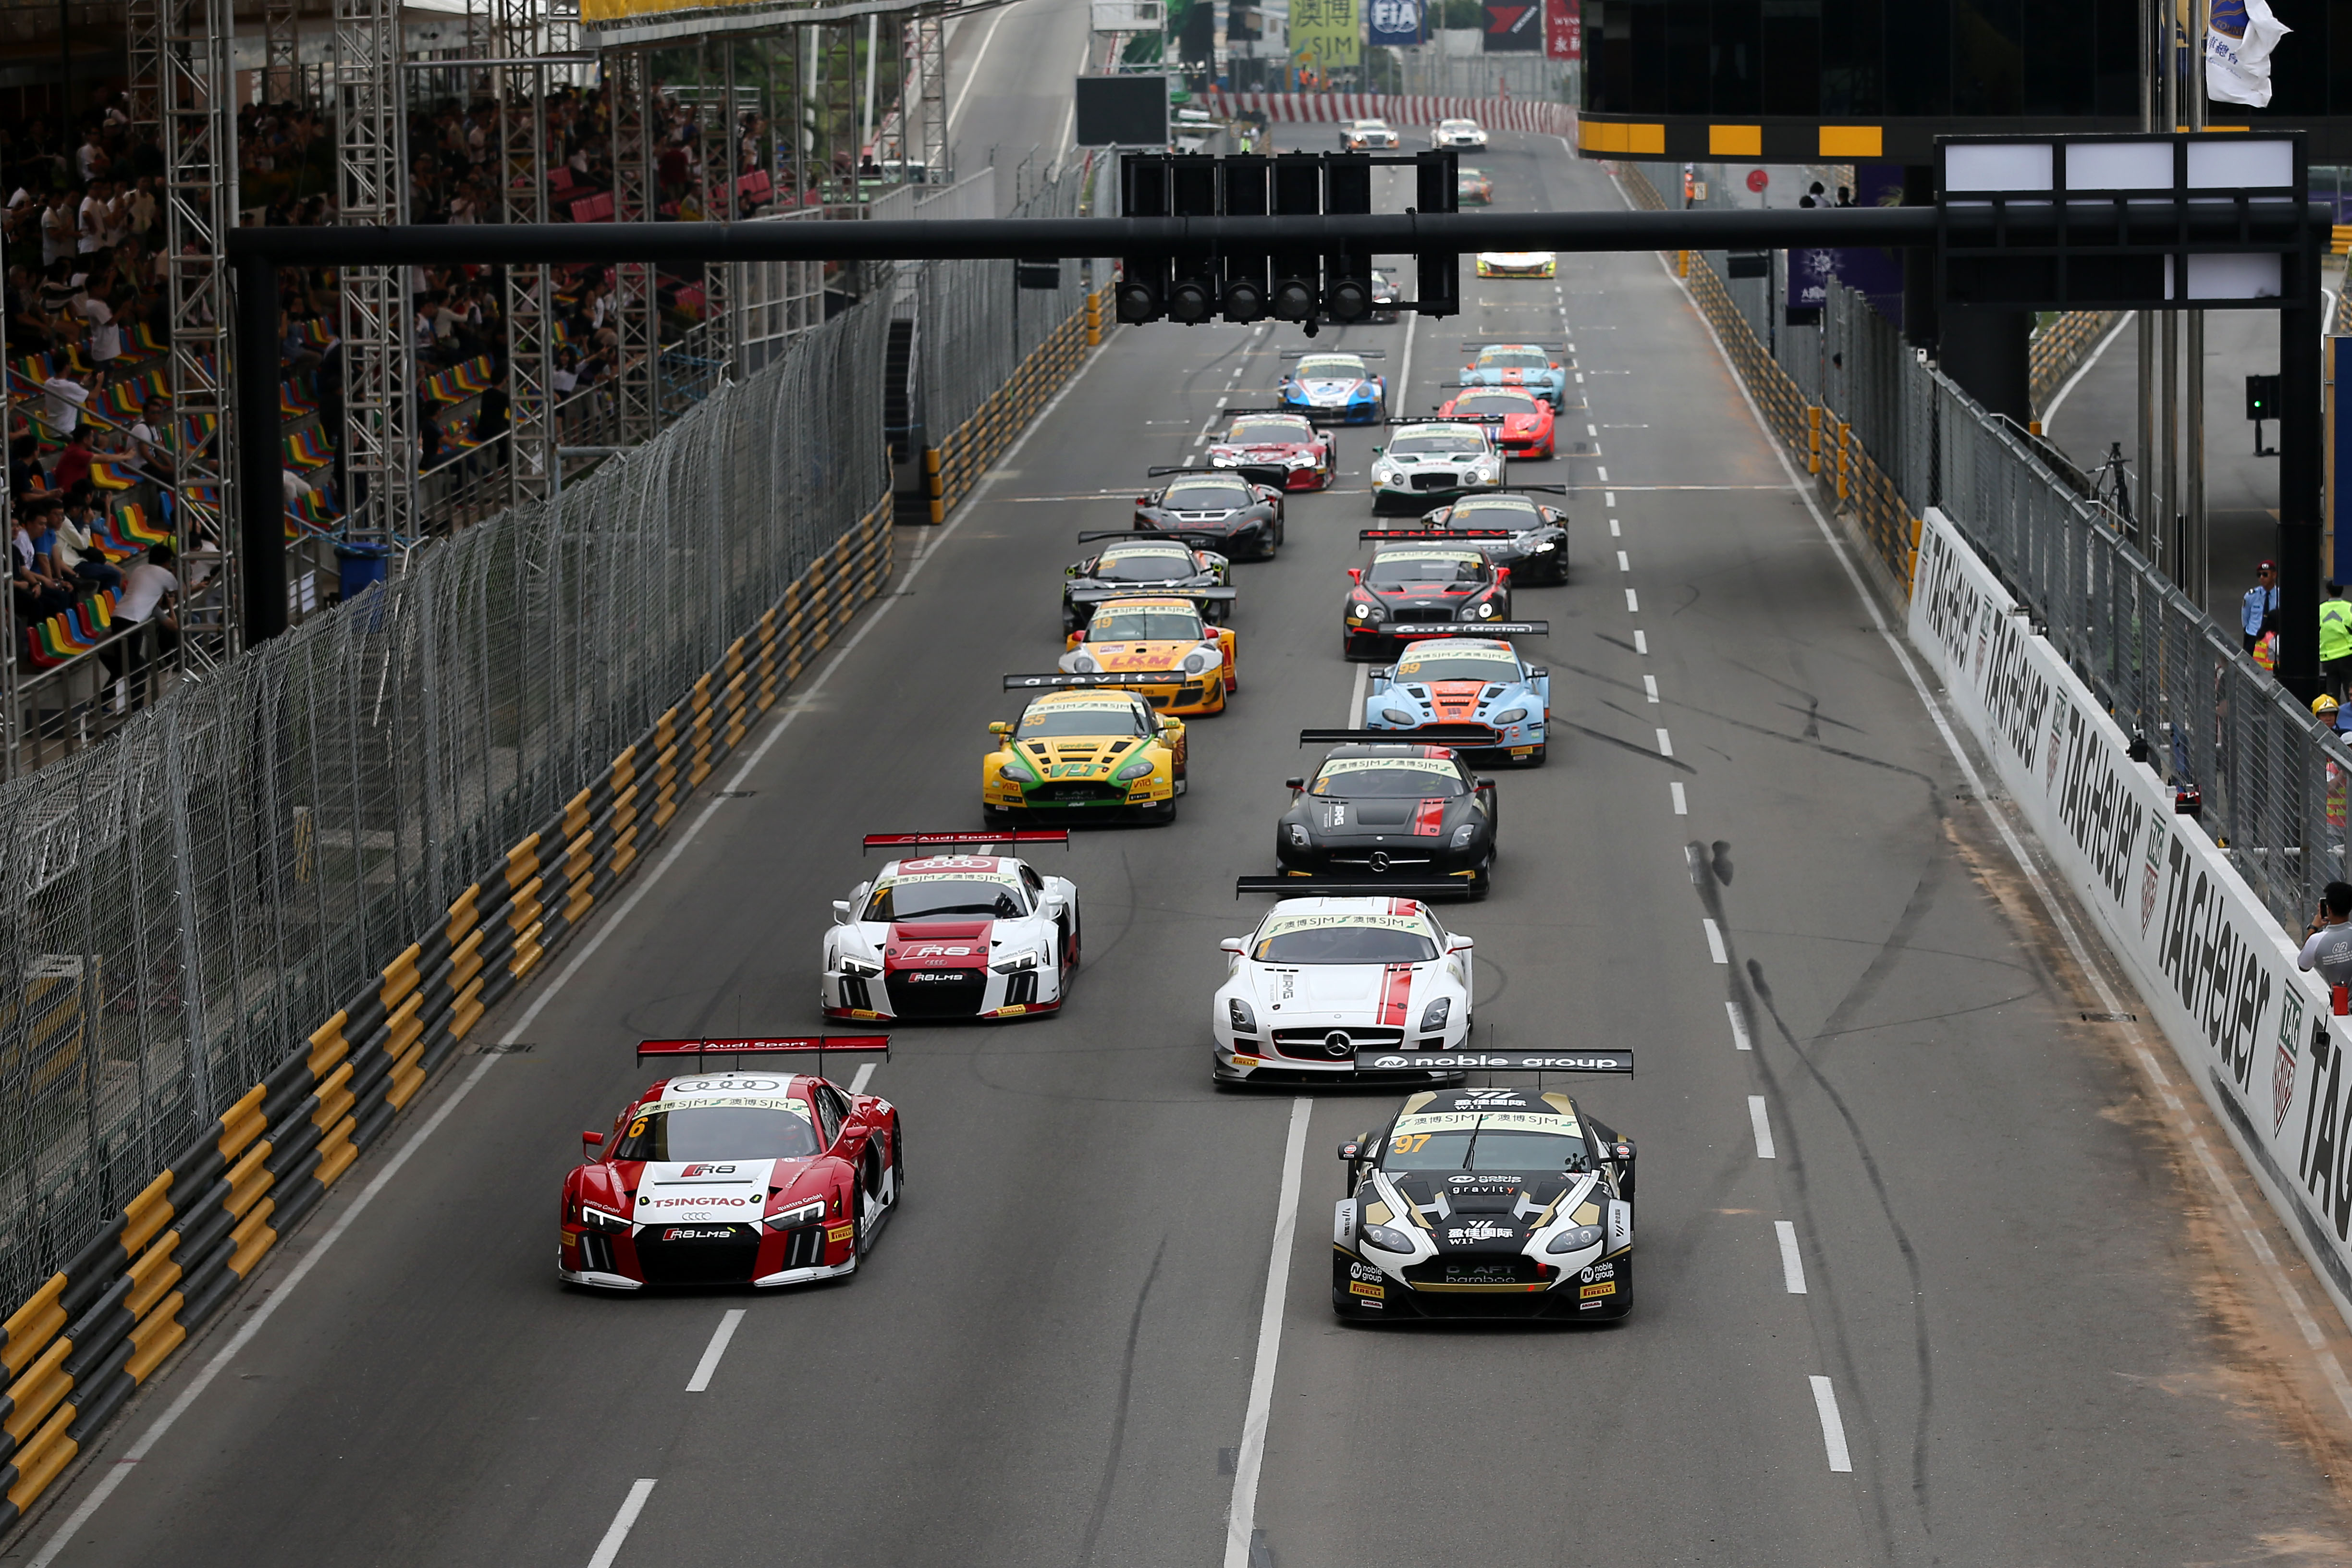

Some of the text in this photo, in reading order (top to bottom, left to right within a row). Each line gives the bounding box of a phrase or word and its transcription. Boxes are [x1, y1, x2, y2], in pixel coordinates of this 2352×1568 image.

[1313, 37, 1351, 60] SJM
[1093, 617, 1113, 629] 19
[1111, 656, 1172, 665] LKM
[1398, 662, 1421, 675] 99
[1023, 714, 1046, 727] 55
[1050, 763, 1106, 778] VLT
[1359, 760, 1380, 768] SJM
[1417, 760, 1438, 770] SJM
[1313, 777, 1330, 794] 2
[2149, 823, 2163, 866] TAG
[911, 874, 935, 884] SJM
[976, 873, 1001, 883] SJM
[873, 889, 889, 906] 7
[1309, 917, 1335, 926] SJM
[1379, 917, 1404, 927] SJM
[1258, 939, 1273, 958] 1
[2332, 942, 2348, 954] 62
[1283, 980, 1293, 999] AMG
[2280, 994, 2301, 1049] TAG
[1415, 1054, 1617, 1069] noble group
[649, 1098, 789, 1113] 澳博 SJM 澳博 SJM
[1414, 1113, 1558, 1126] 澳博 SJM 澳博 SJM
[628, 1116, 649, 1138] 6
[1394, 1134, 1432, 1154] 97
[693, 1165, 736, 1175] R8
[1452, 1186, 1514, 1194] gravity
[583, 1199, 621, 1214] quattro GmbH
[653, 1198, 746, 1208] TSINGTAO
[777, 1193, 823, 1211] quattro GmbH
[1447, 1228, 1513, 1238] 盈佳国际
[1363, 1265, 1382, 1275] noble
[1594, 1262, 1613, 1272] noble
[1362, 1273, 1382, 1283] group
[1595, 1270, 1614, 1281] group
[1353, 1284, 1381, 1297] PIRELLI
[1583, 1284, 1612, 1297] PIRELLI
